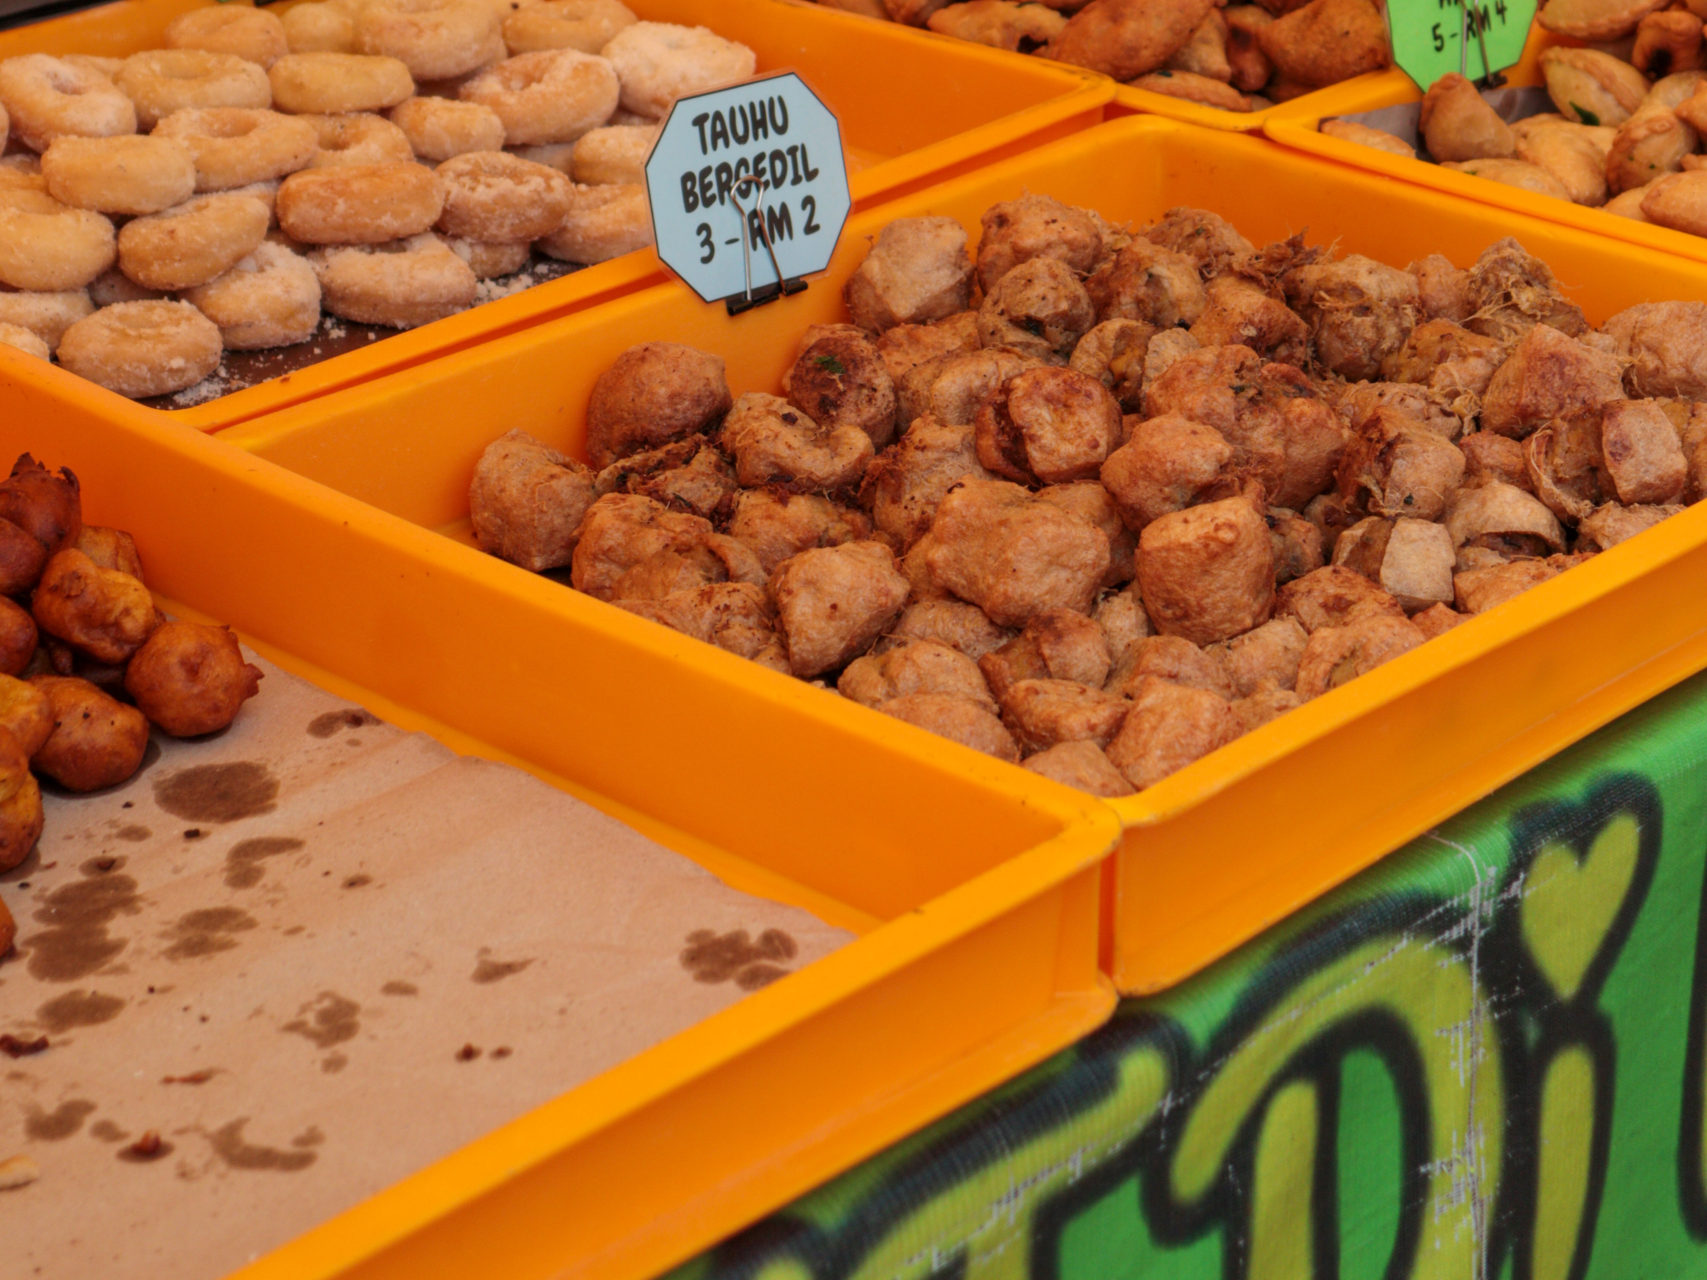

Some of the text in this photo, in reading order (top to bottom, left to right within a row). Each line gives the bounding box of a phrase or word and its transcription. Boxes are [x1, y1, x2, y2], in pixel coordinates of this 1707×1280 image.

[1431, 23, 1444, 52] 5
[1465, 4, 1491, 41] RM
[692, 95, 789, 155] TAUHU
[680, 143, 819, 213] BERGEDIL
[696, 223, 715, 264] 3
[748, 201, 793, 251] RM
[801, 195, 820, 235] 2
